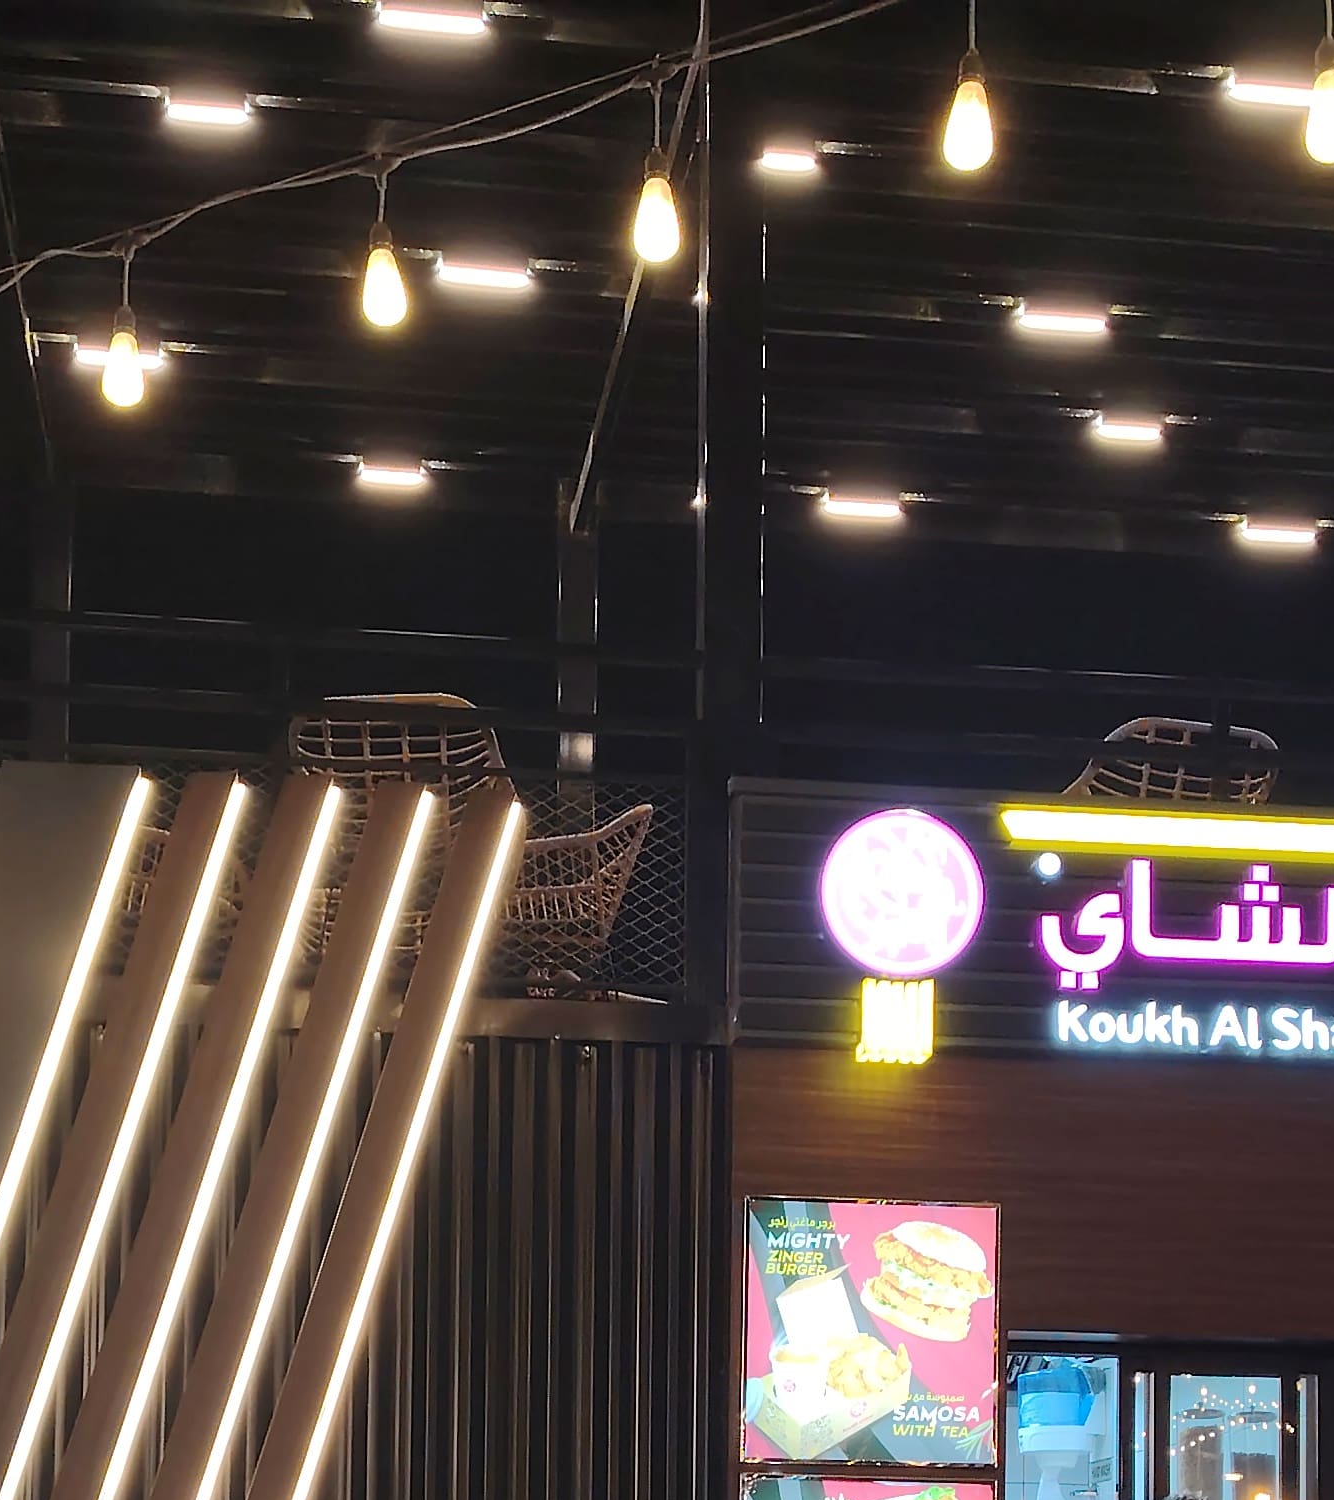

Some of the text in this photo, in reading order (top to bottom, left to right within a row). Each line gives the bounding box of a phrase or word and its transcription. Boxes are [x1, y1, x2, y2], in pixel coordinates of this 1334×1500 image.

[1056, 1000, 1200, 1046] Koukh
[1209, 1005, 1262, 1050] Al
[767, 1231, 851, 1250] MIGHTY
[768, 1249, 824, 1264] ZINGER
[764, 1262, 829, 1276] BURGER
[892, 1405, 980, 1422] SAMOSA
[892, 1424, 969, 1438] WITH TEA
